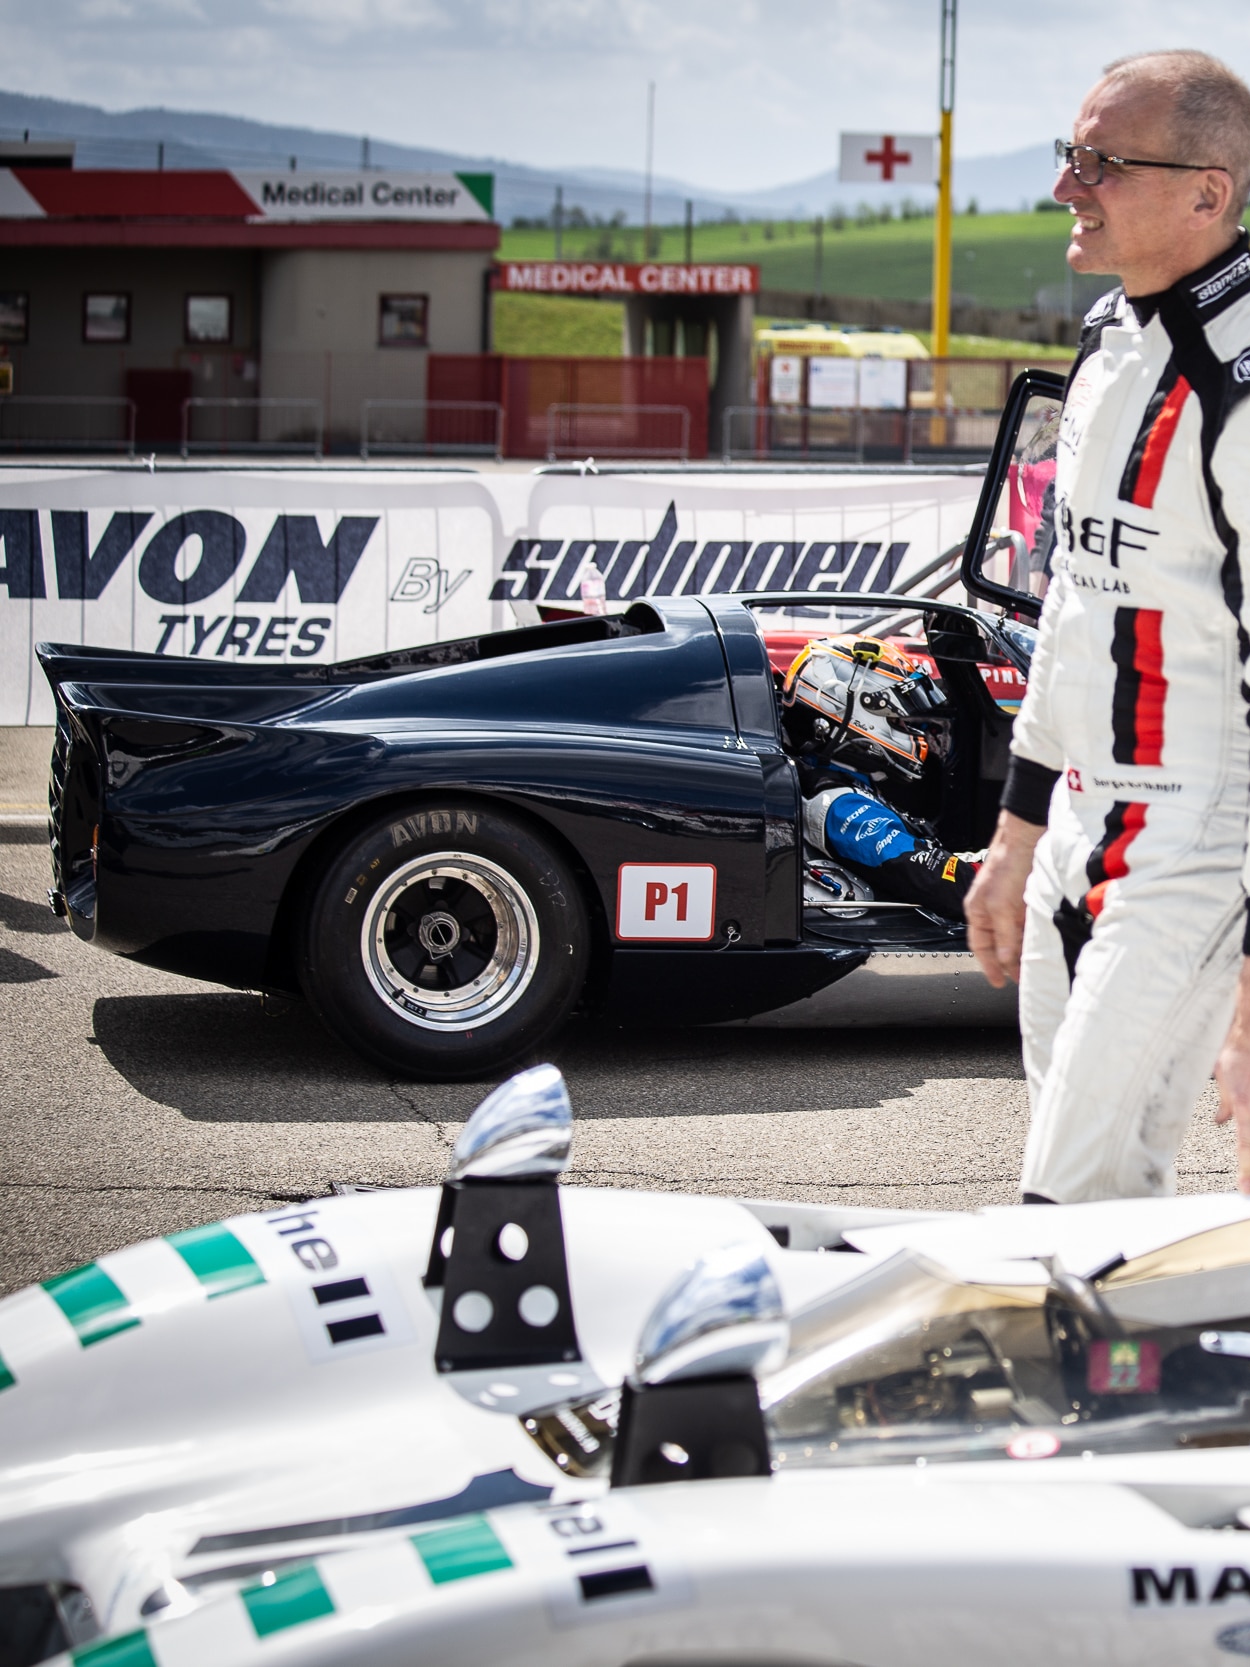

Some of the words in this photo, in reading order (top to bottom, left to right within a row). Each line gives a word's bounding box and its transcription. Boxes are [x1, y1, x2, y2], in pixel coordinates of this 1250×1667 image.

[262, 181, 364, 207] Medical
[371, 182, 460, 210] Center
[507, 265, 634, 292] MEDICAL
[638, 267, 753, 293] CENTER
[0, 507, 381, 605] AVON
[390, 556, 473, 614] By
[156, 614, 333, 658] TYRES
[901, 680, 917, 694] 33
[391, 809, 478, 849] AVON
[643, 881, 689, 922] P1
[266, 1210, 386, 1345] hell
[549, 1515, 655, 1600] ell
